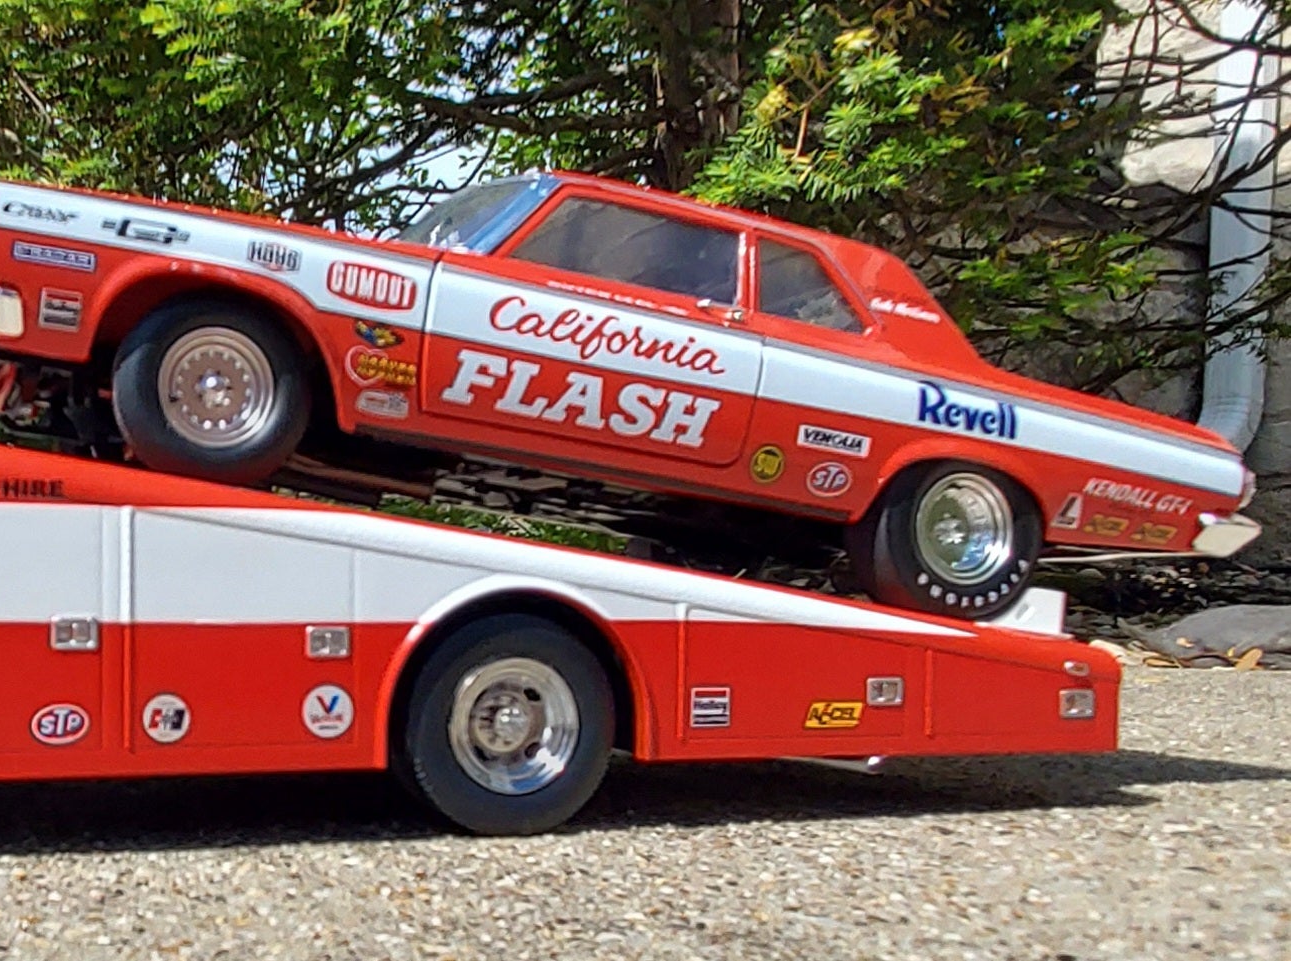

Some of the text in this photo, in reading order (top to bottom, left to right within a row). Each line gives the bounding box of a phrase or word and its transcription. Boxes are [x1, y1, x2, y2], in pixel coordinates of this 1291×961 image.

[330, 262, 414, 308] GUMOUT
[488, 295, 726, 376] California
[441, 349, 723, 449] FLASH
[917, 380, 1018, 440] Revell
[2, 479, 65, 498] HIRE
[812, 465, 847, 489] STP
[1083, 477, 1159, 508] KENDALL
[39, 708, 82, 736] STP
